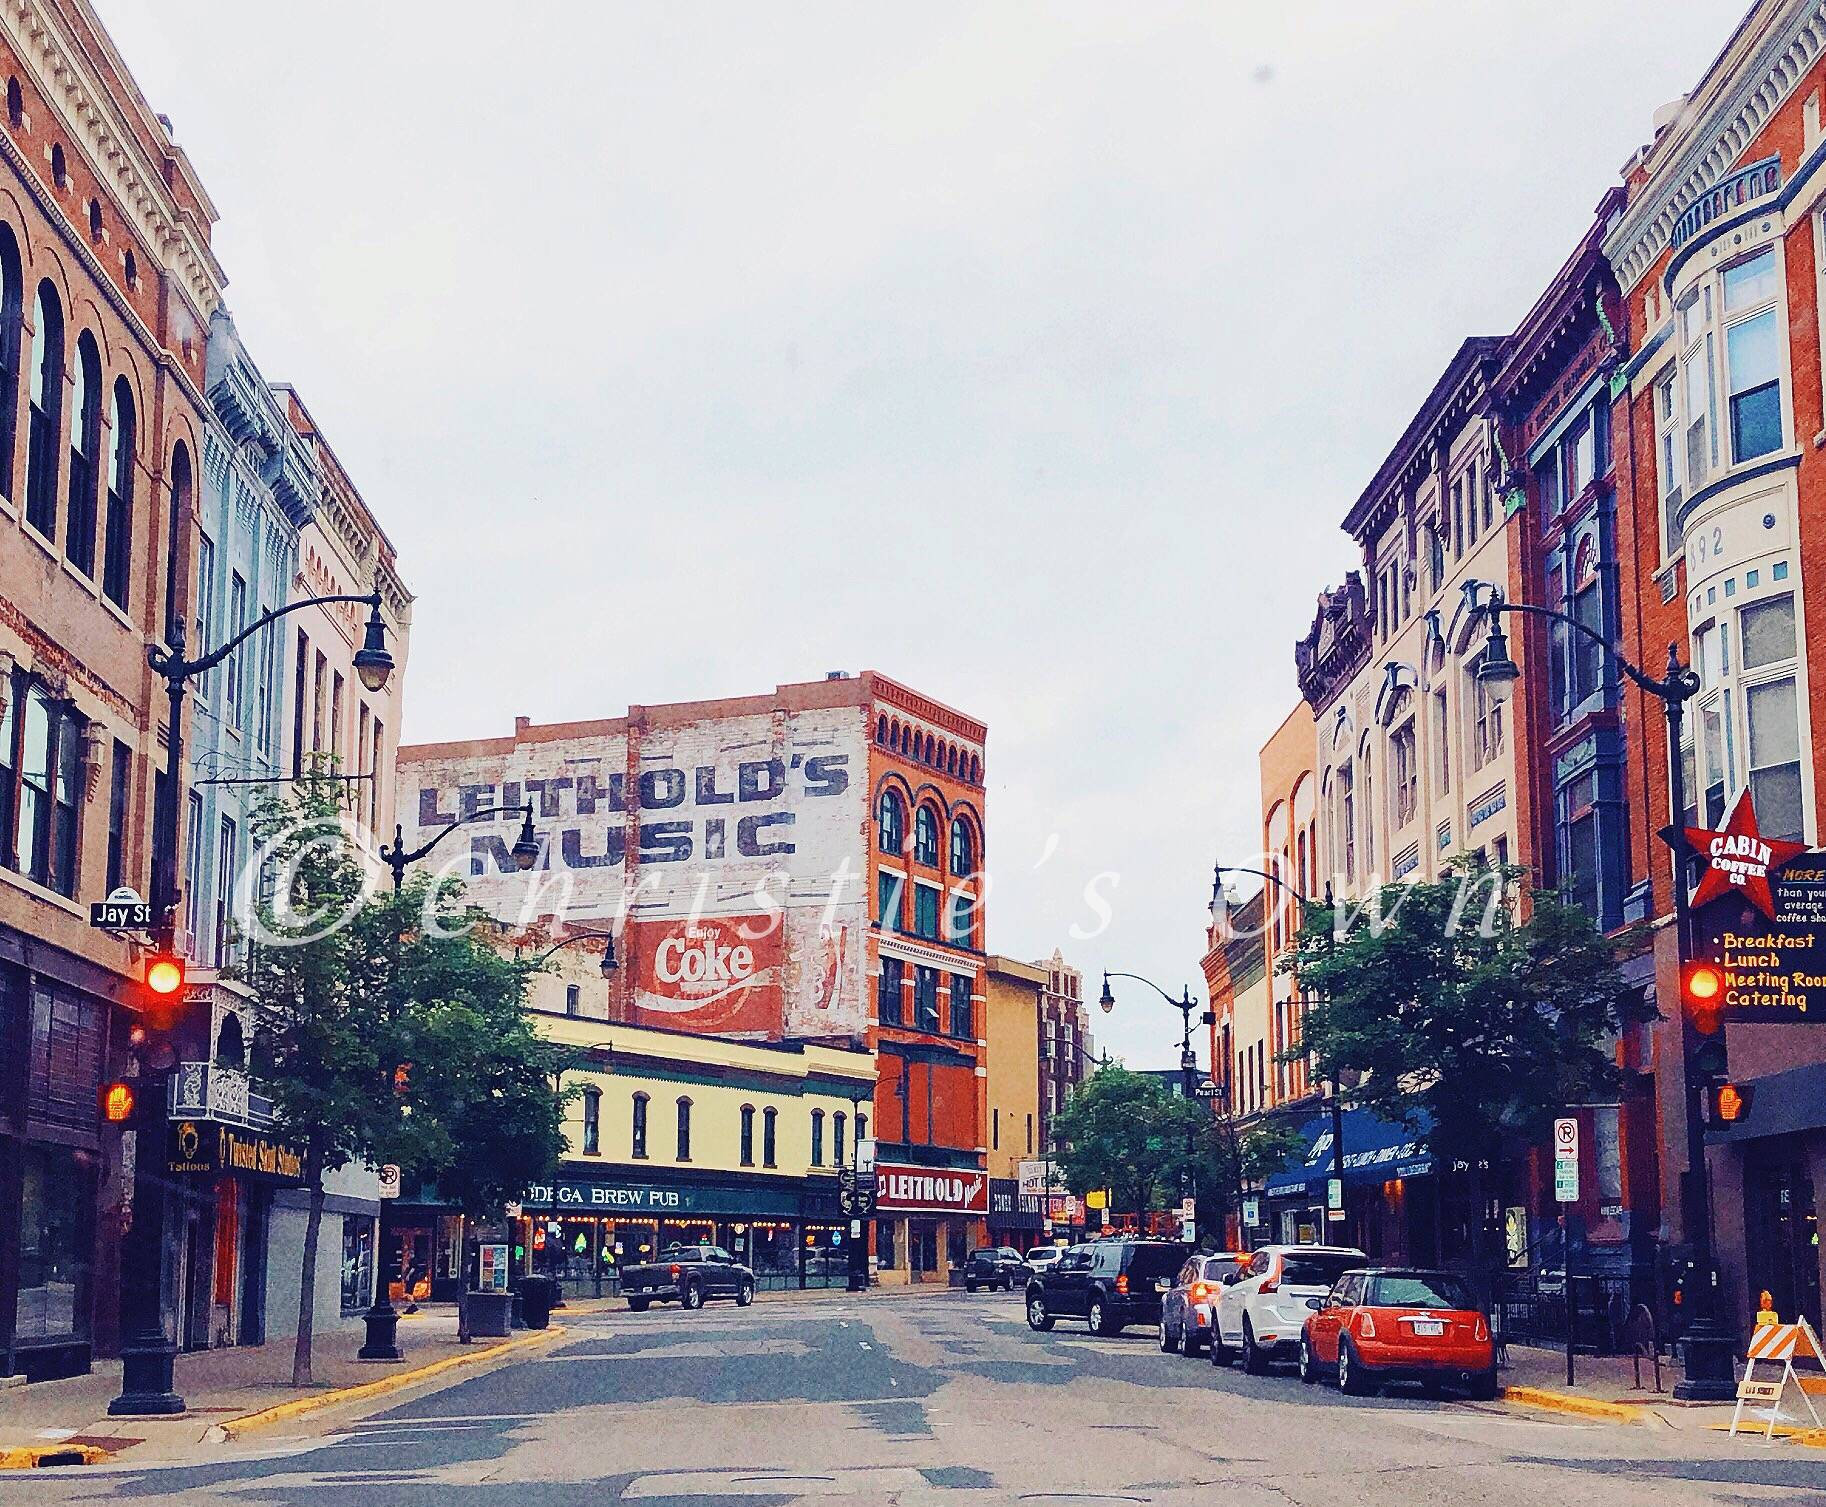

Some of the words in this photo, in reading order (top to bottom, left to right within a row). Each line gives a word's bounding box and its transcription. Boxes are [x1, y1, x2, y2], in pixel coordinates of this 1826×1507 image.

[418, 753, 849, 826] LEITHOLD'S
[470, 811, 796, 874] MUSIC
[1710, 835, 1773, 866] CABIN
[1711, 857, 1767, 878] COFFEE
[1782, 869, 1825, 881] MORE
[1777, 887, 1803, 897] than
[96, 904, 129, 927] Jay
[133, 904, 152, 923] St
[1776, 912, 1807, 922] coffee
[1810, 912, 1826, 922] sho
[1784, 901, 1824, 914] average
[688, 926, 722, 940] Enjoy
[1723, 932, 1816, 949] Breakfast
[654, 938, 754, 983] Coke
[1723, 951, 1780, 967] Lunch
[1724, 971, 1789, 993] Meeting
[1725, 990, 1807, 1013] Catering
[591, 1188, 644, 1205] BREW
[649, 1191, 679, 1206] PUB
[888, 1174, 964, 1202] LEITHOLD
